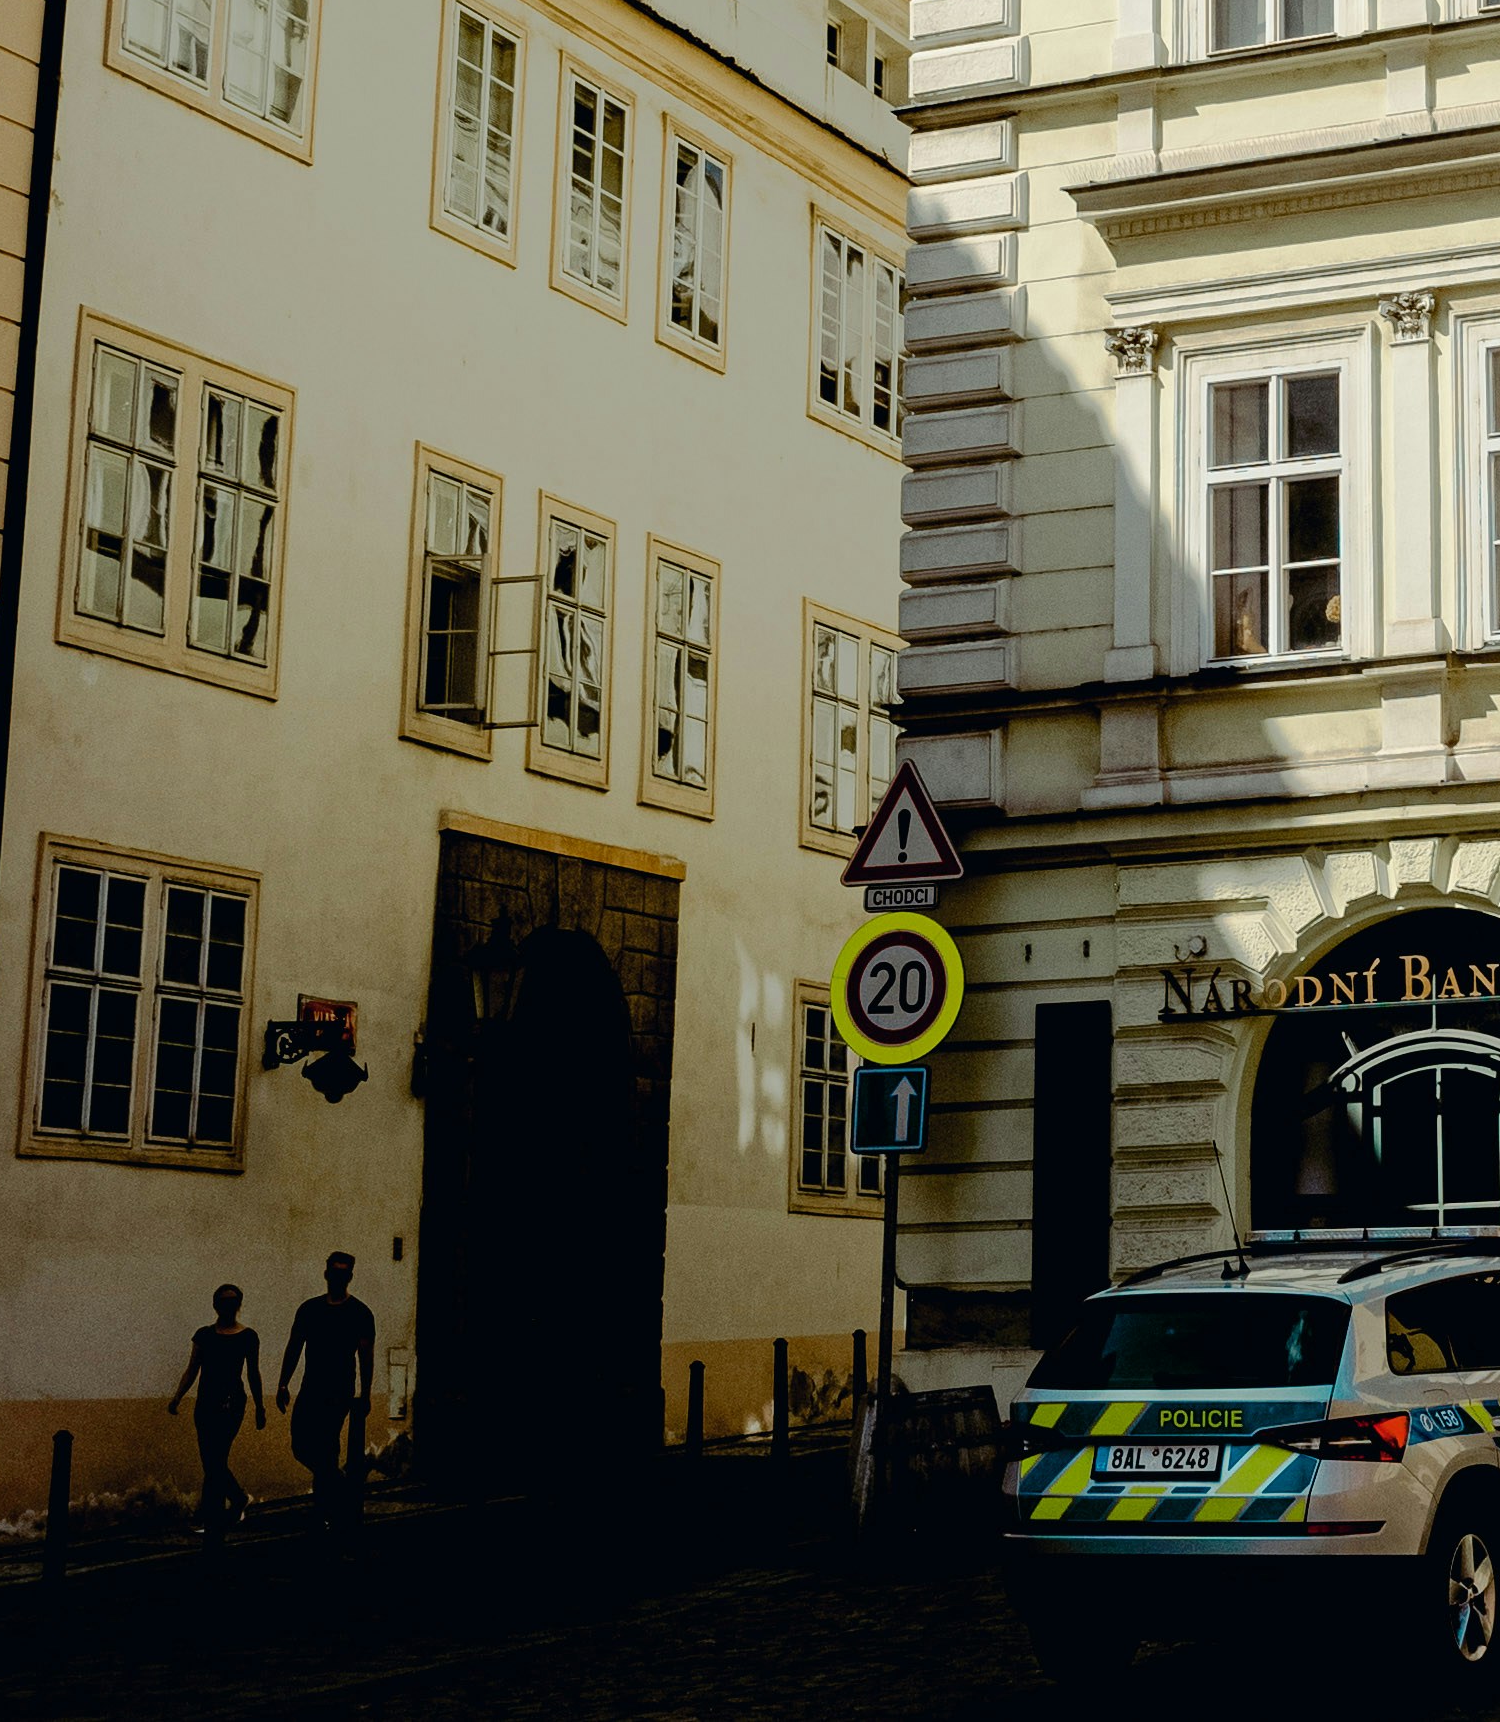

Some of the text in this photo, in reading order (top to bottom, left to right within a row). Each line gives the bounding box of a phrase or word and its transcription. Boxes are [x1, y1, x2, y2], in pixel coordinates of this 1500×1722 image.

[872, 888, 928, 906] CHODCI
[867, 960, 928, 1015] 20
[1160, 1410, 1244, 1428] POLICIE
[1435, 1409, 1460, 1429] 158
[1111, 1447, 1210, 1470] 8AL 6248
